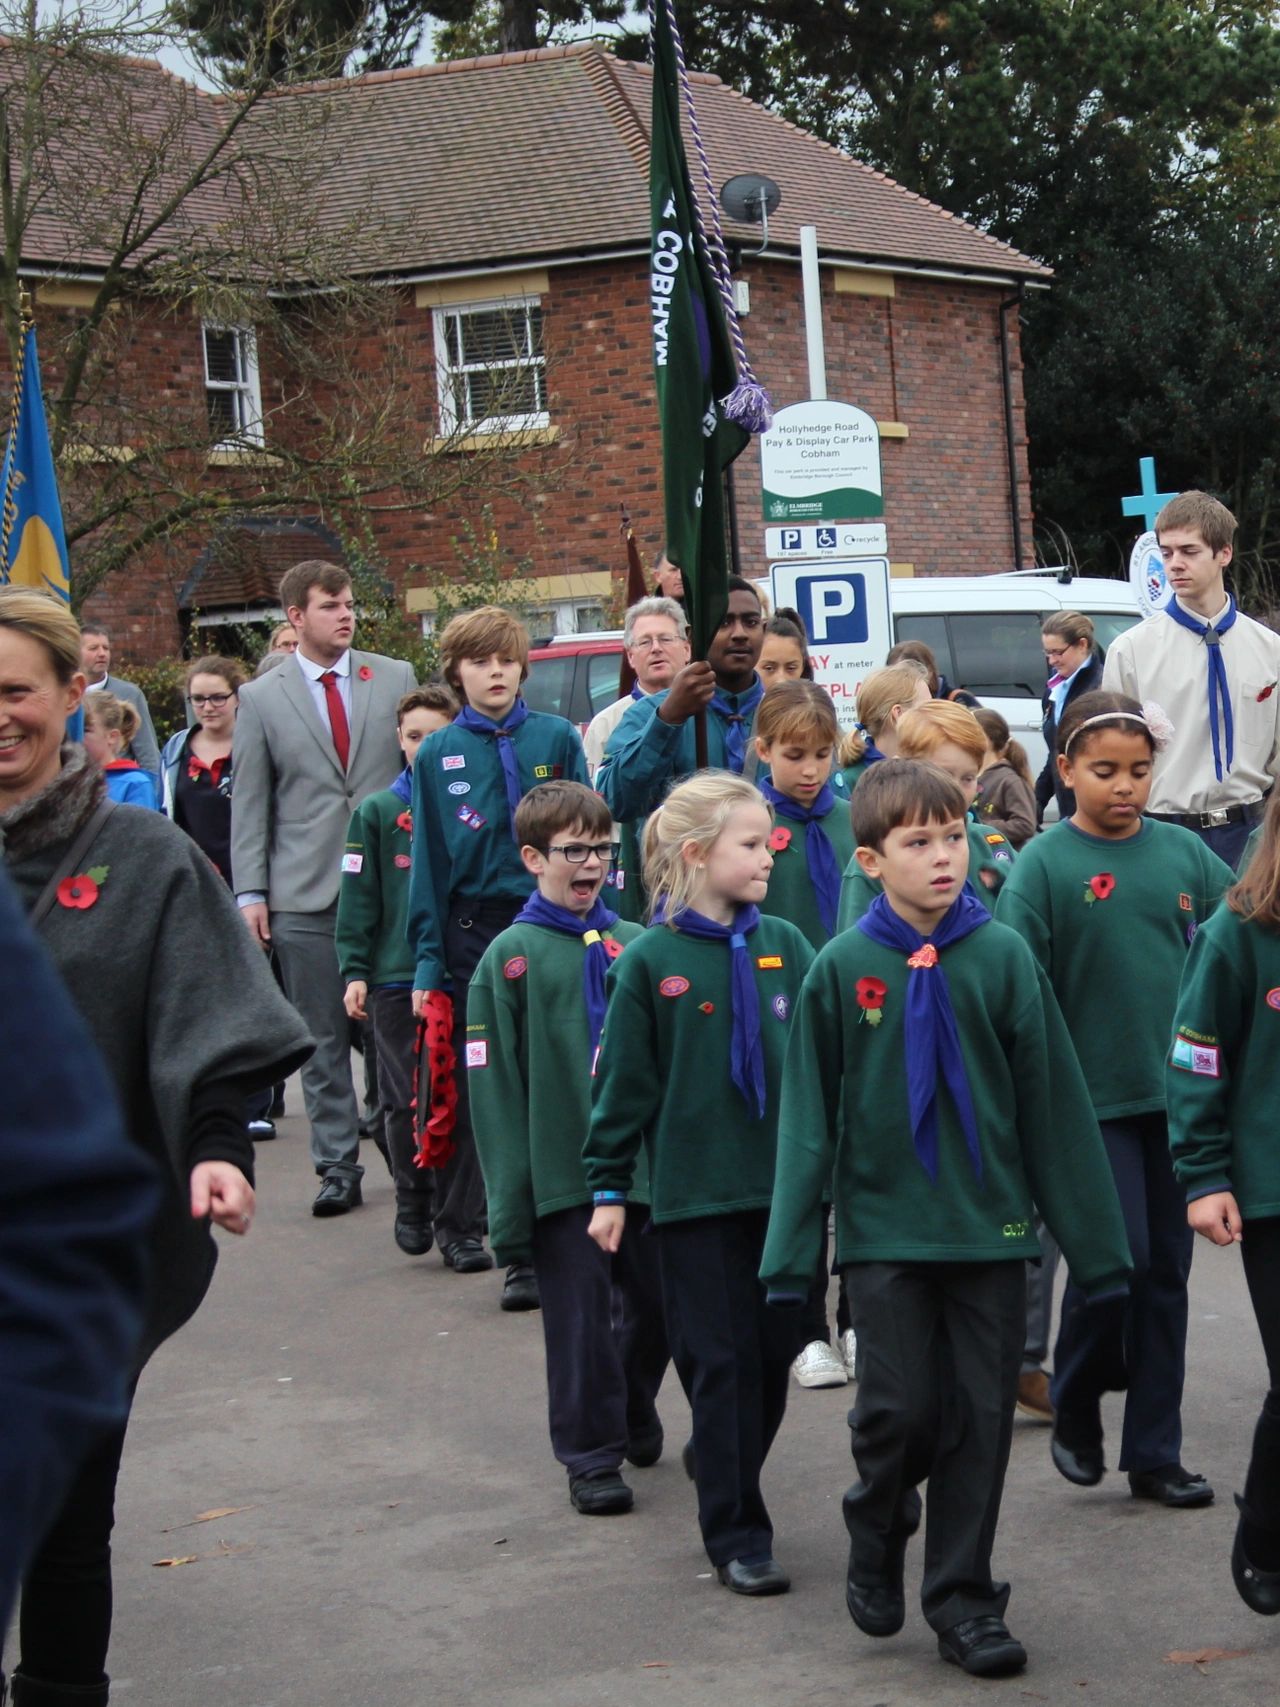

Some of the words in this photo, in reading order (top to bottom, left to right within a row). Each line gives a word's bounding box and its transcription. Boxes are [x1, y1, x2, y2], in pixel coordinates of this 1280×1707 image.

[779, 424, 832, 434] Hollyhedge
[834, 422, 859, 431] Road
[765, 438, 783, 448] Pay
[786, 438, 793, 446] &
[796, 437, 831, 447] Display
[833, 436, 850, 444] Car
[852, 434, 874, 443] Park
[801, 449, 840, 458] Cobham
[856, 536, 880, 544] recycle
[811, 580, 855, 639] P
[807, 655, 831, 670] AY
[834, 661, 844, 669] at
[847, 660, 874, 668] meter
